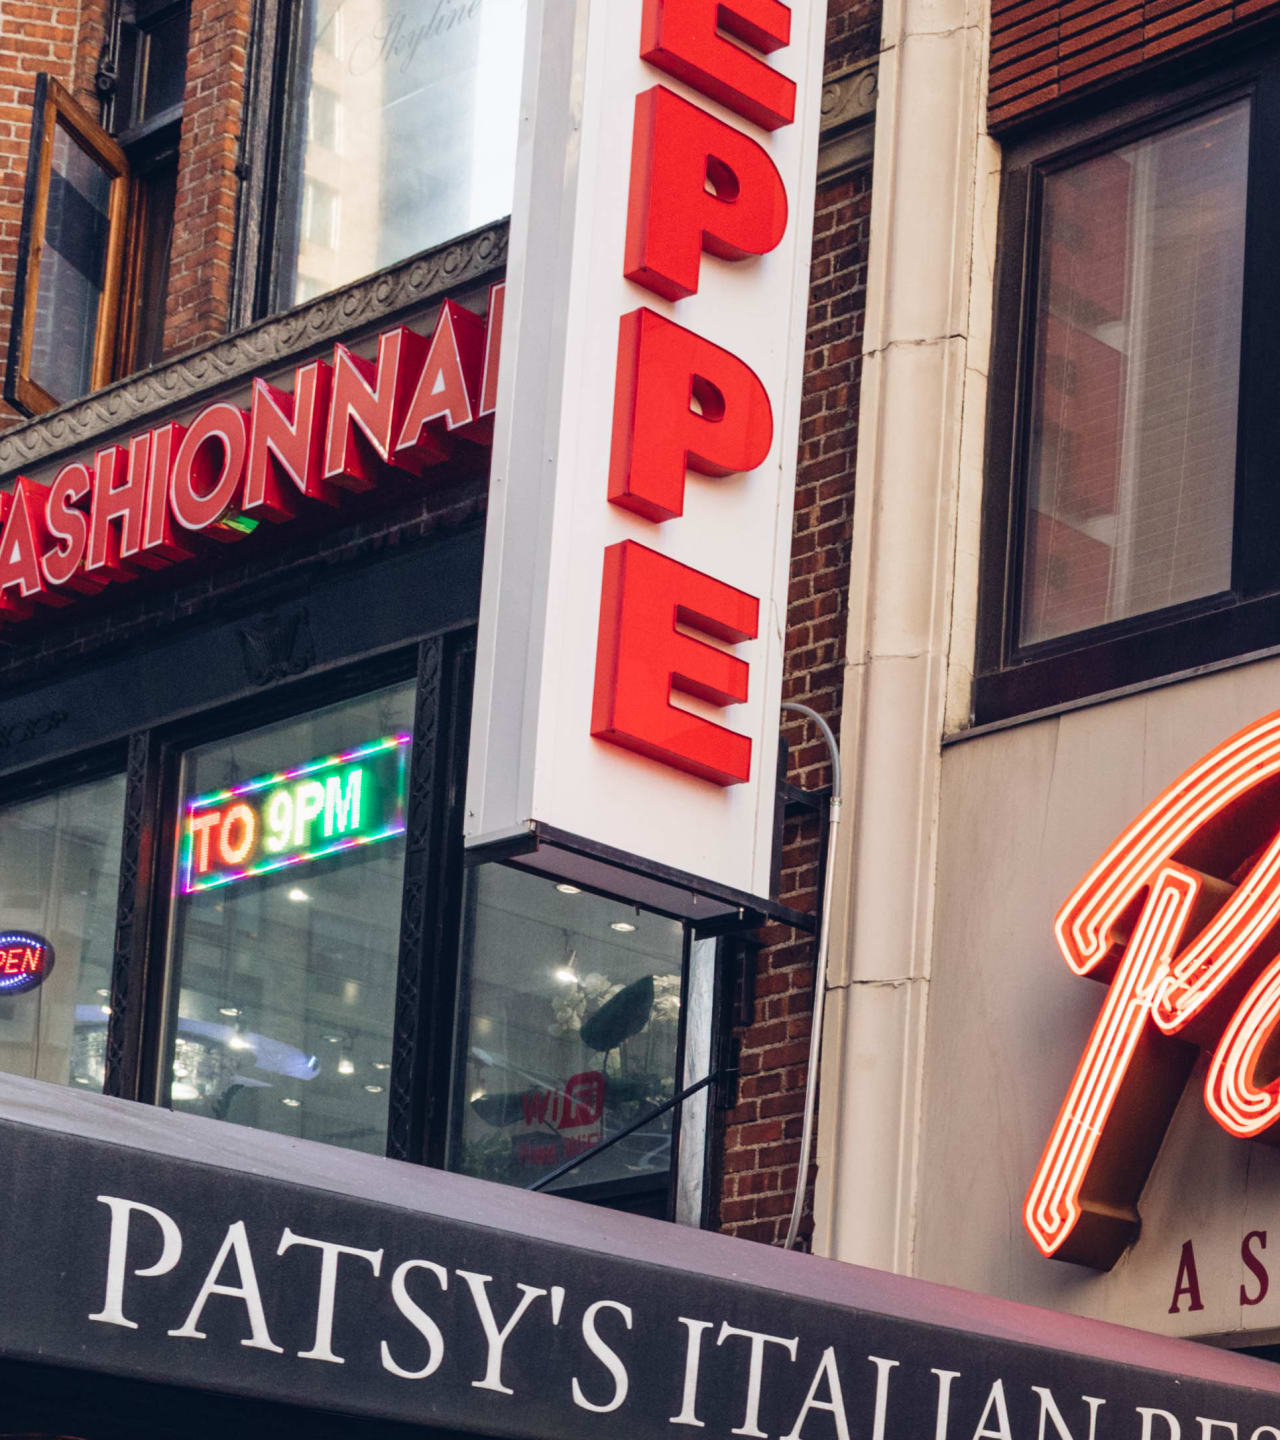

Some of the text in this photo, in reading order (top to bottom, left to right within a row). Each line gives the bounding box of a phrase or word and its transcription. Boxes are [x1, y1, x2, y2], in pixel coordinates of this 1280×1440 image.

[191, 768, 363, 873] TO 9PM
[88, 1195, 634, 1414] PATSY'S
[1168, 1240, 1205, 1315] A
